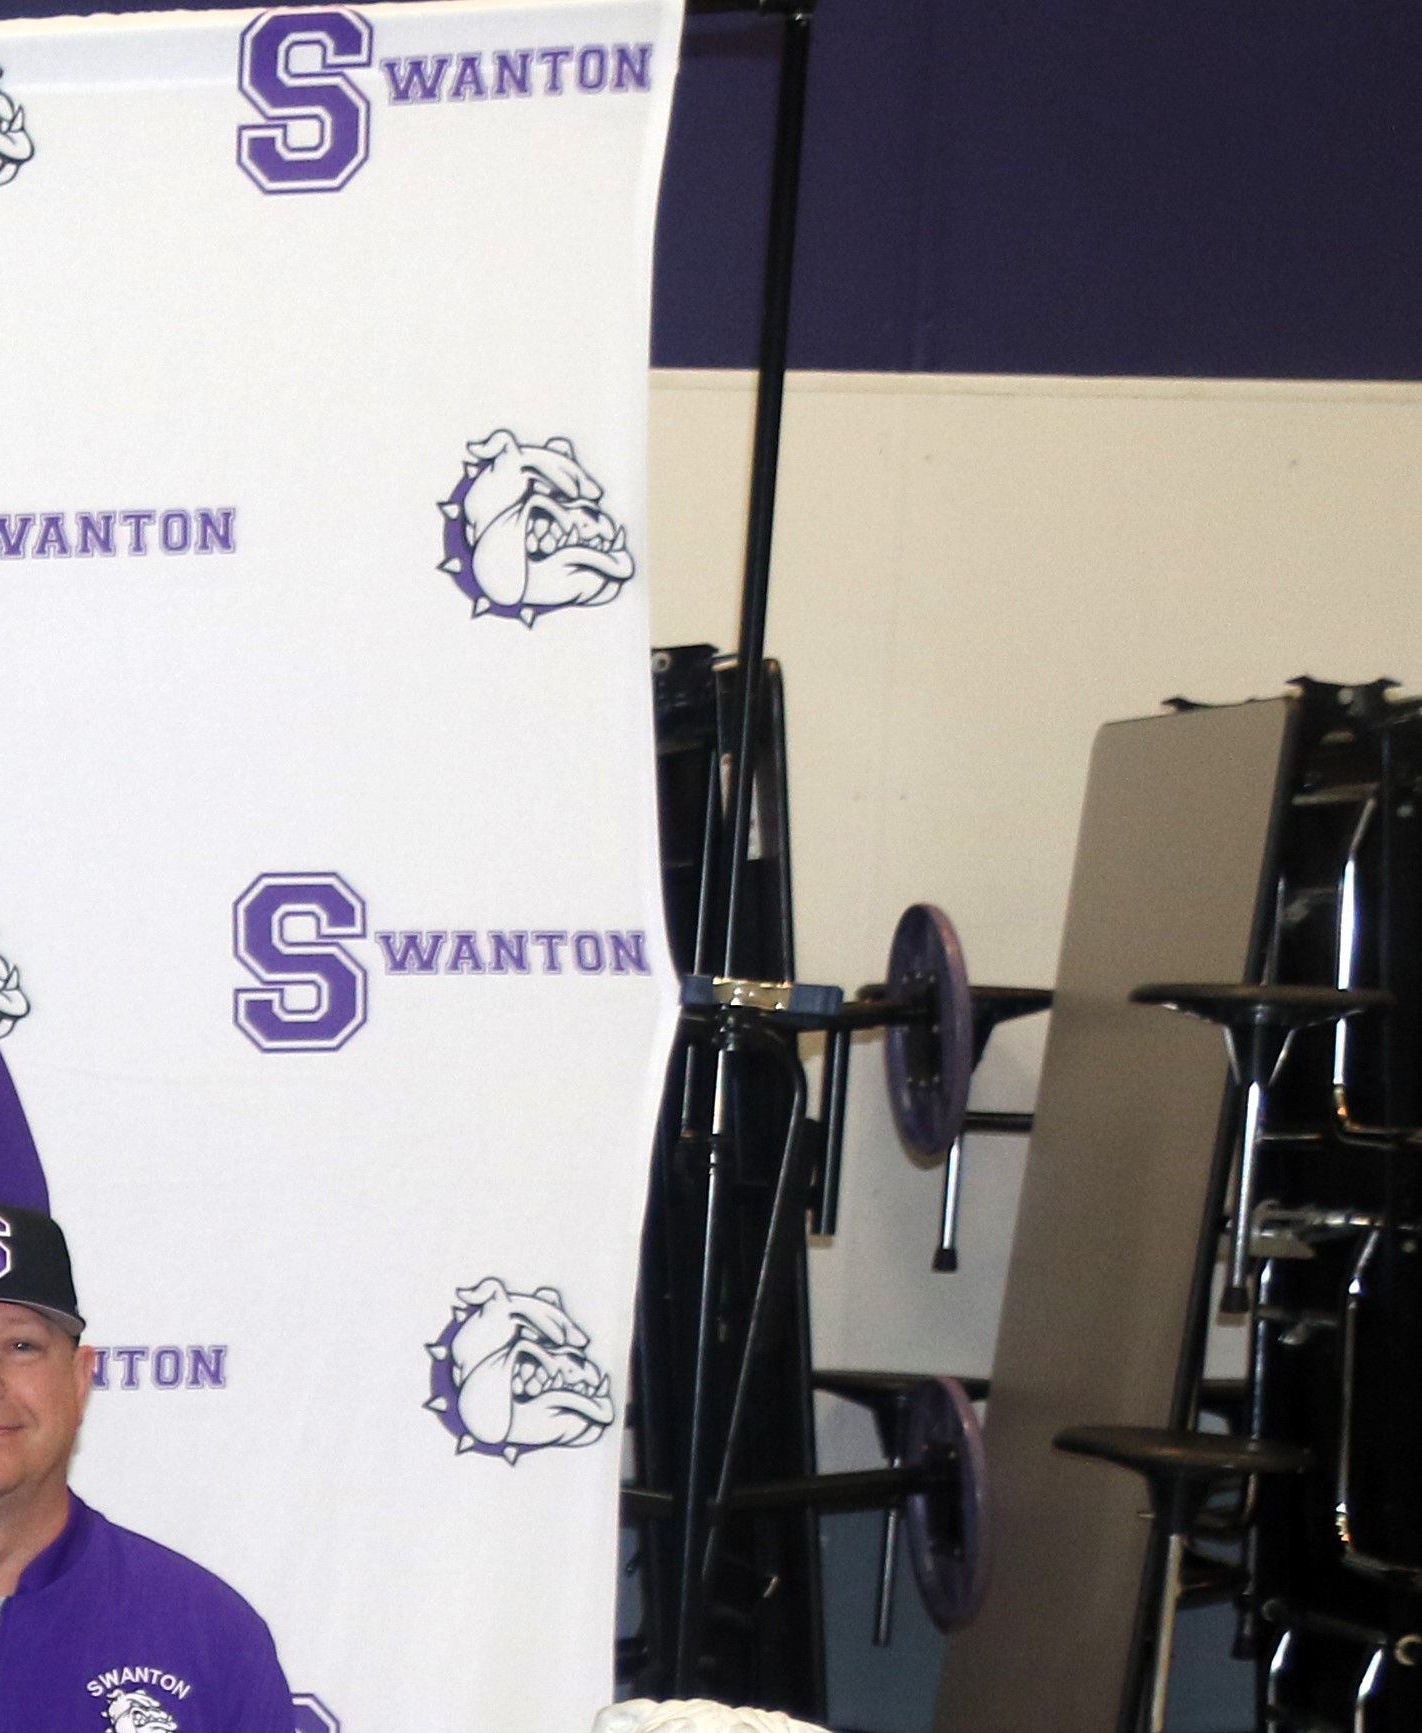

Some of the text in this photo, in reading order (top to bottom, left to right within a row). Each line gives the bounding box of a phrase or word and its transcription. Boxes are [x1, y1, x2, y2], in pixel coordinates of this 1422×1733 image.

[236, 6, 653, 194] SWANTON
[233, 872, 651, 1053] SWANTON
[86, 1666, 191, 1700] SWANTON
